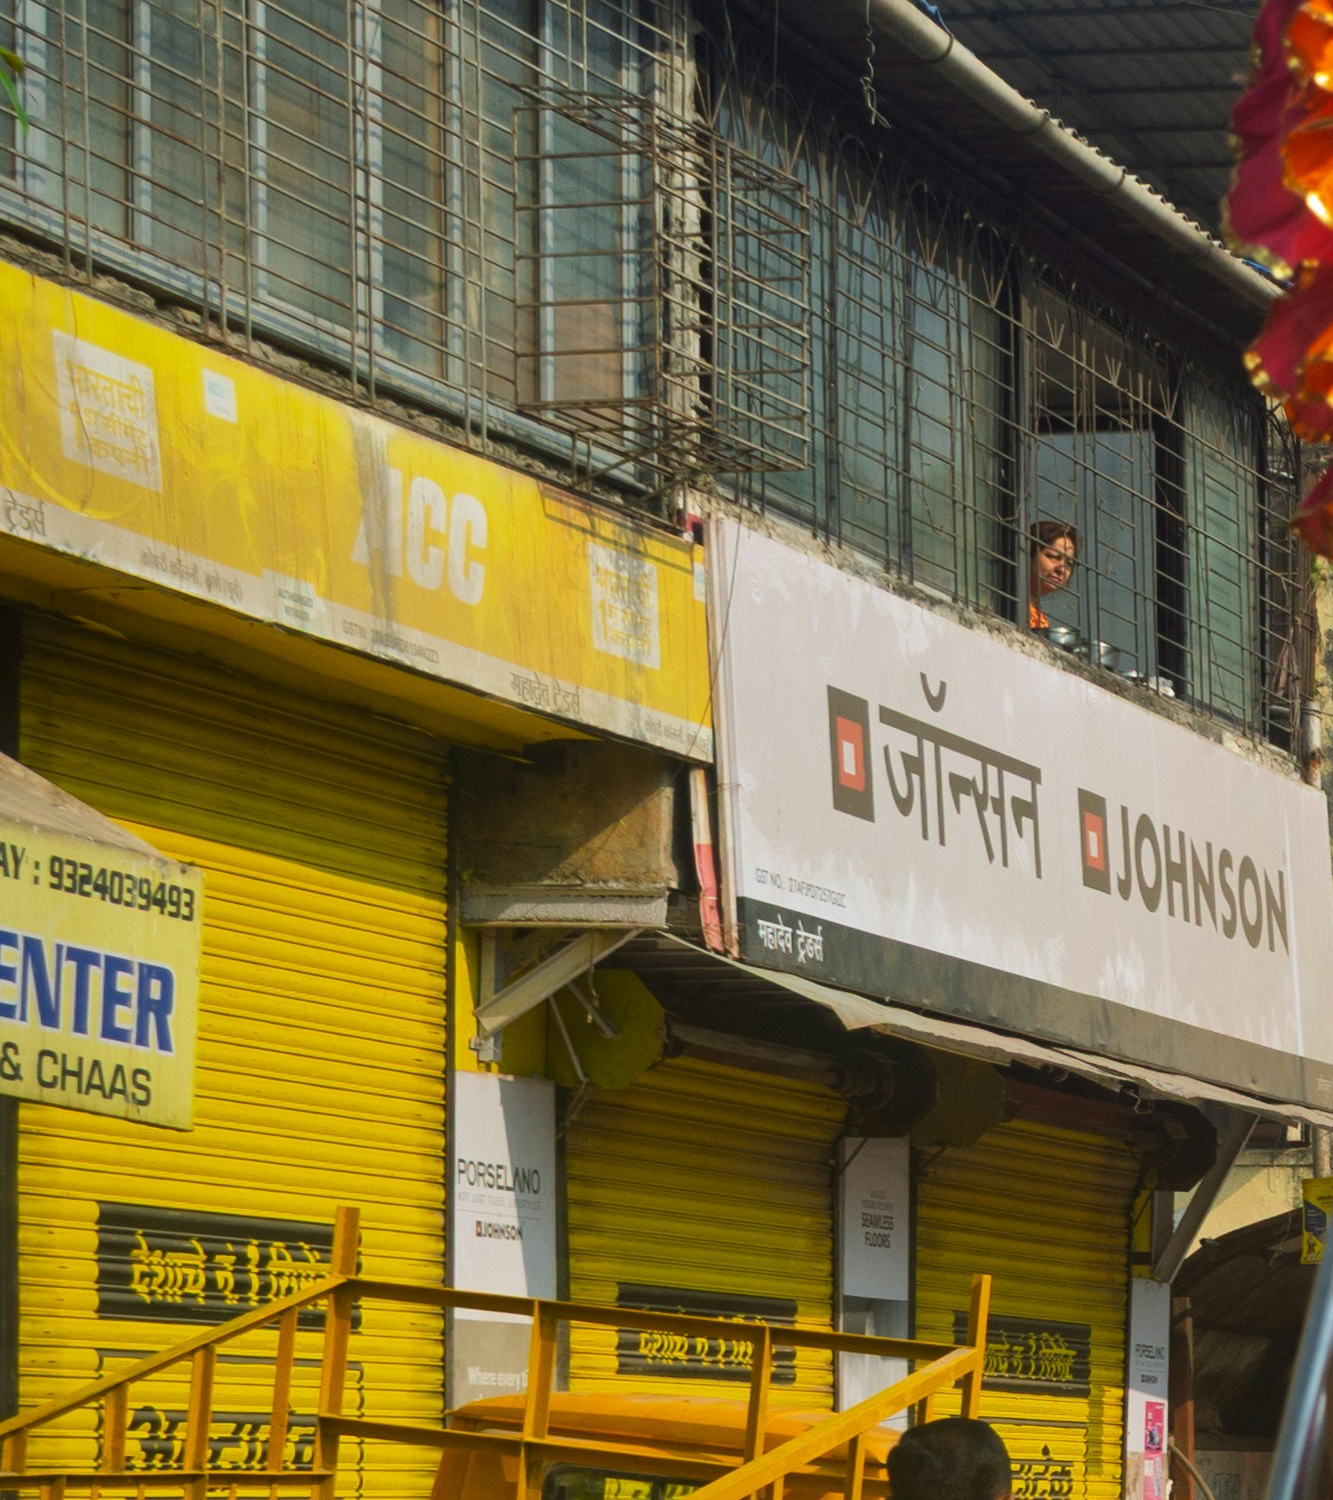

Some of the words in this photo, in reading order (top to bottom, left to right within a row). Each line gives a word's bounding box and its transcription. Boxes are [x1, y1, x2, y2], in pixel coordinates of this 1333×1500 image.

[351, 464, 489, 606] ACC
[878, 671, 1043, 880] जॉन्सन
[48, 854, 195, 923] 9324039493
[1116, 804, 1290, 957] JOHNSON
[756, 913, 793, 954] महादेव
[795, 919, 824, 964] ट्रेडर्स
[0, 1040, 24, 1082] &
[36, 1048, 152, 1108] CHAAS
[458, 1157, 541, 1194] PORSELANO
[483, 1221, 524, 1241] JOHNSON
[861, 1211, 895, 1231] SEAMLESS
[864, 1231, 891, 1249] FLOORS
[467, 1367, 497, 1387] Where
[497, 1369, 523, 1392] every
